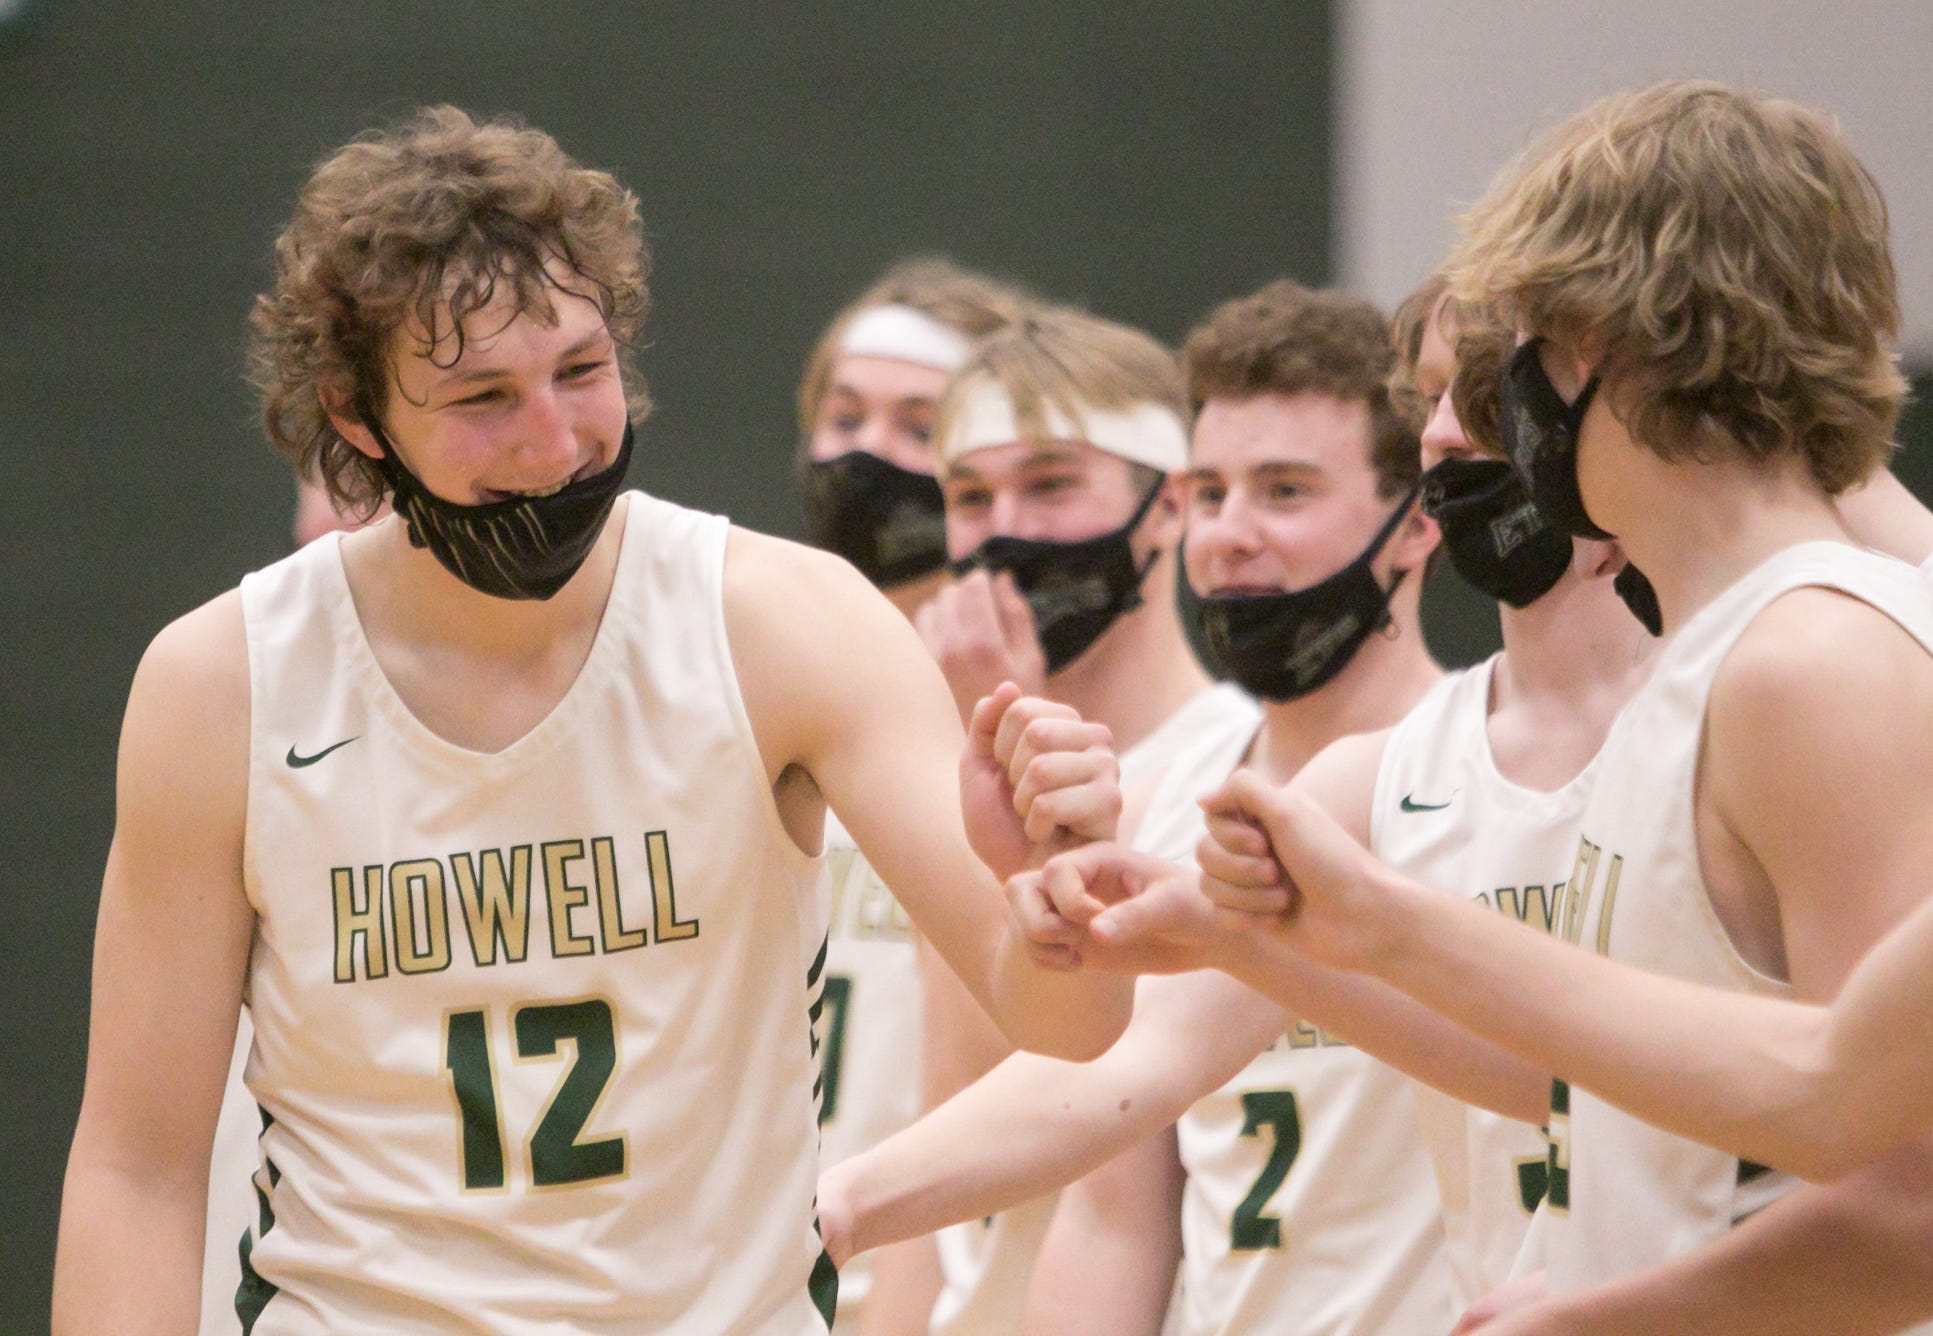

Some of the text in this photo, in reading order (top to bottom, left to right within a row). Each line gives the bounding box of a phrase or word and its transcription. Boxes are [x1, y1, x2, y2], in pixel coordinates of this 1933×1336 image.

[330, 830, 700, 984] HOWELL
[442, 994, 629, 1194] 12
[1228, 1088, 1303, 1252] 2
